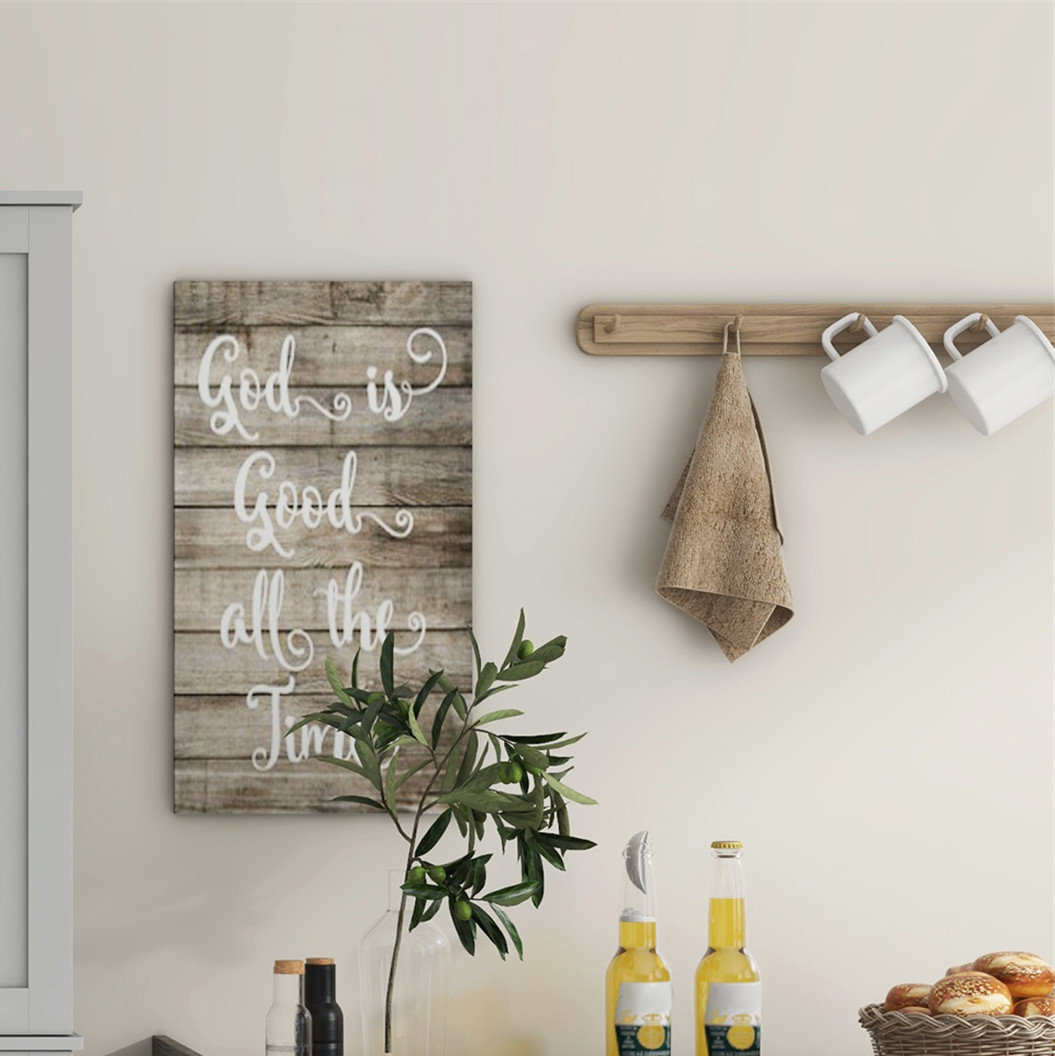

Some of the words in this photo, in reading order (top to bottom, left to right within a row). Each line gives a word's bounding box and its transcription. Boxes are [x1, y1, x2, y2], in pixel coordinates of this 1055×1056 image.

[197, 334, 351, 441] God
[366, 328, 448, 422] is
[234, 451, 414, 558] Good
[220, 568, 314, 671] all
[314, 562, 426, 656] the
[246, 675, 400, 771] Tim
